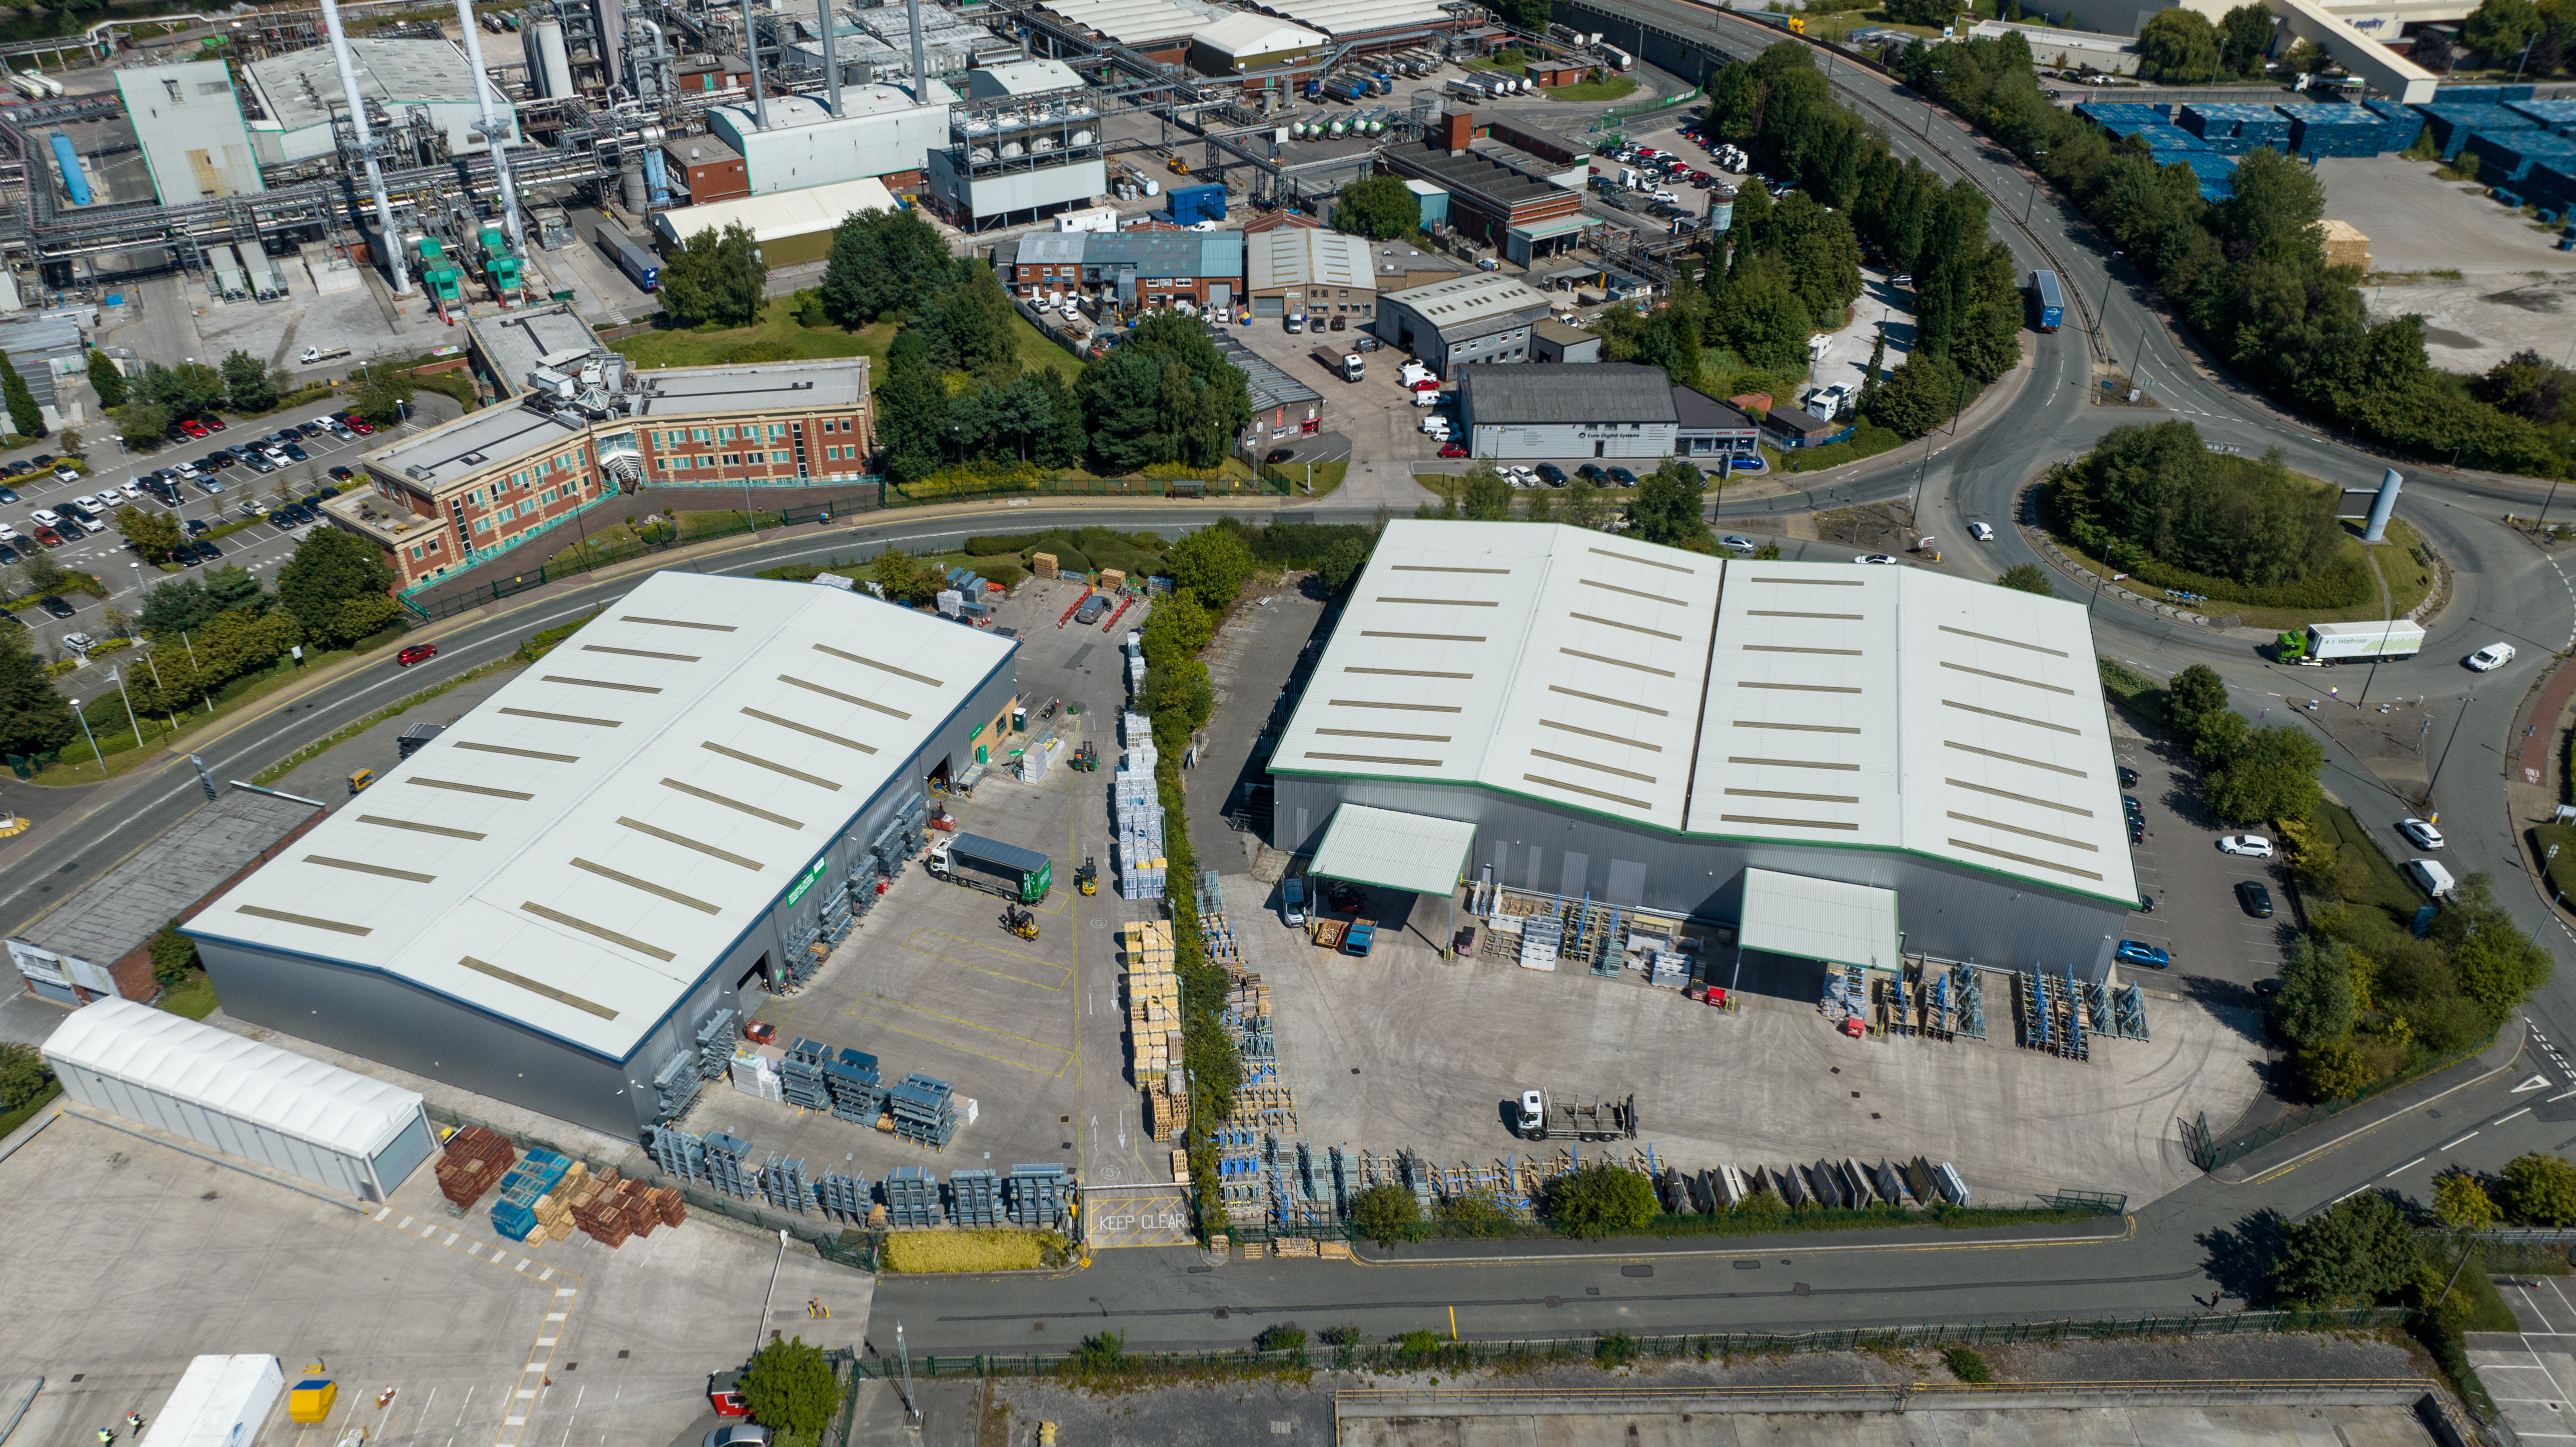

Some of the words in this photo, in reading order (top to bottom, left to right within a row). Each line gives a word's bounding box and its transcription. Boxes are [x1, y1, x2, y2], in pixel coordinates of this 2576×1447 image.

[1106, 1168, 1115, 1177] 5
[1100, 1215, 1134, 1230] KEEP
[1142, 1213, 1185, 1229] CLEAR
